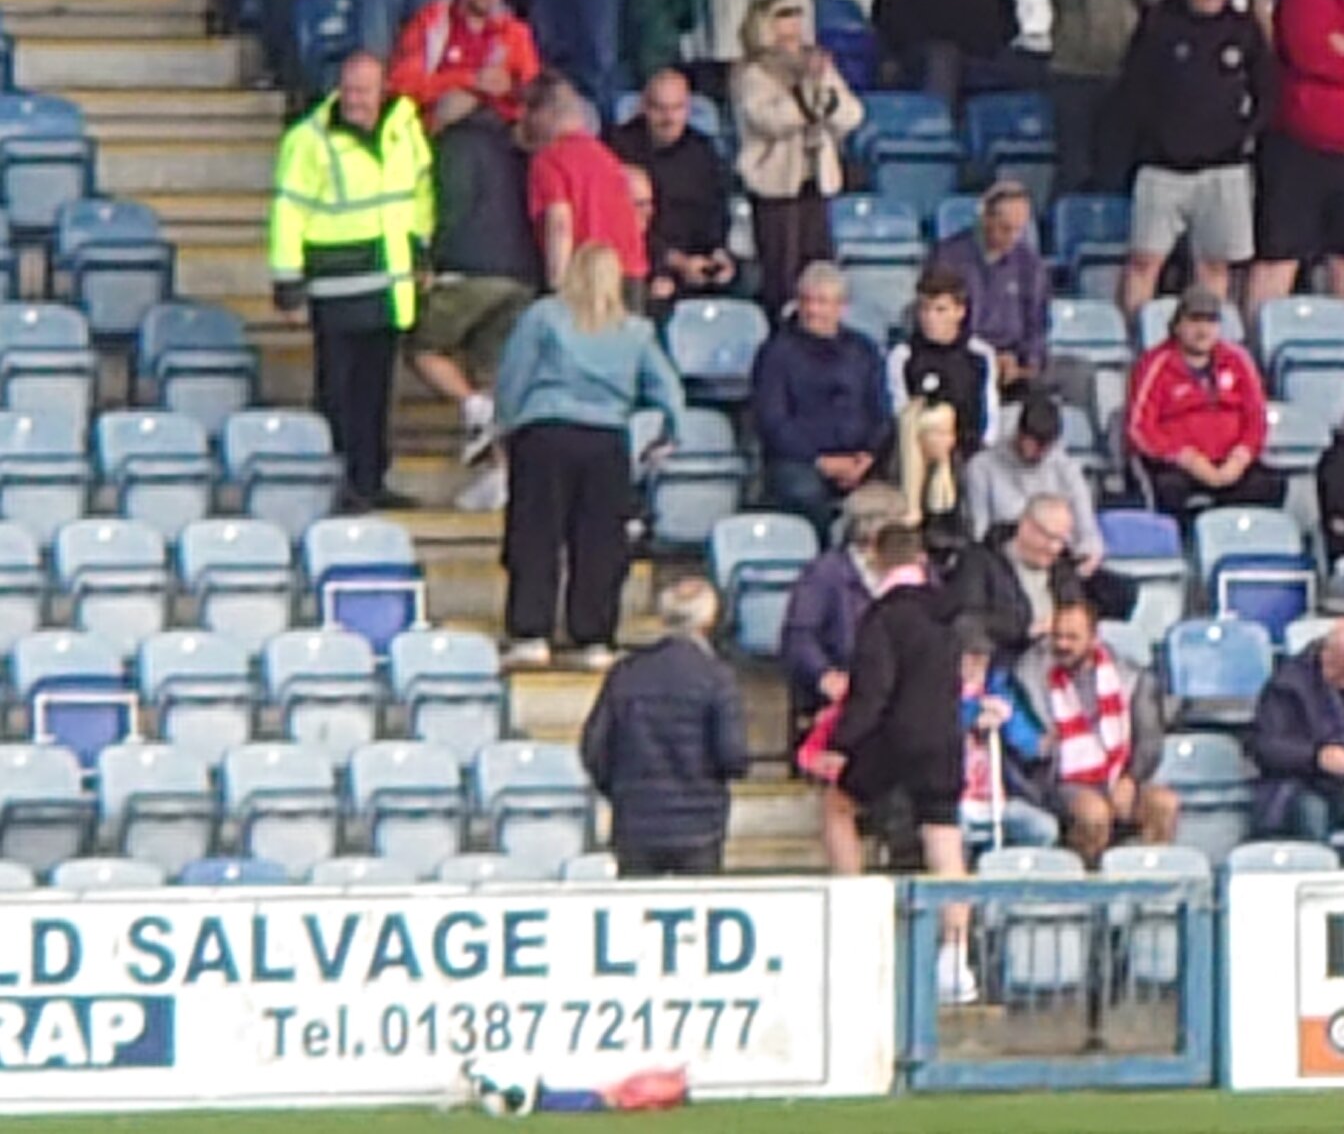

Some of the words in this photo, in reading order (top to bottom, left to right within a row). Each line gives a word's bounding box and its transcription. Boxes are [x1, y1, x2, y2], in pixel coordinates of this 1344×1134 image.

[126, 910, 549, 985] SALVAGE
[594, 907, 783, 977] LTD.
[381, 998, 547, 1056] 01387
[565, 996, 762, 1052] 721777
